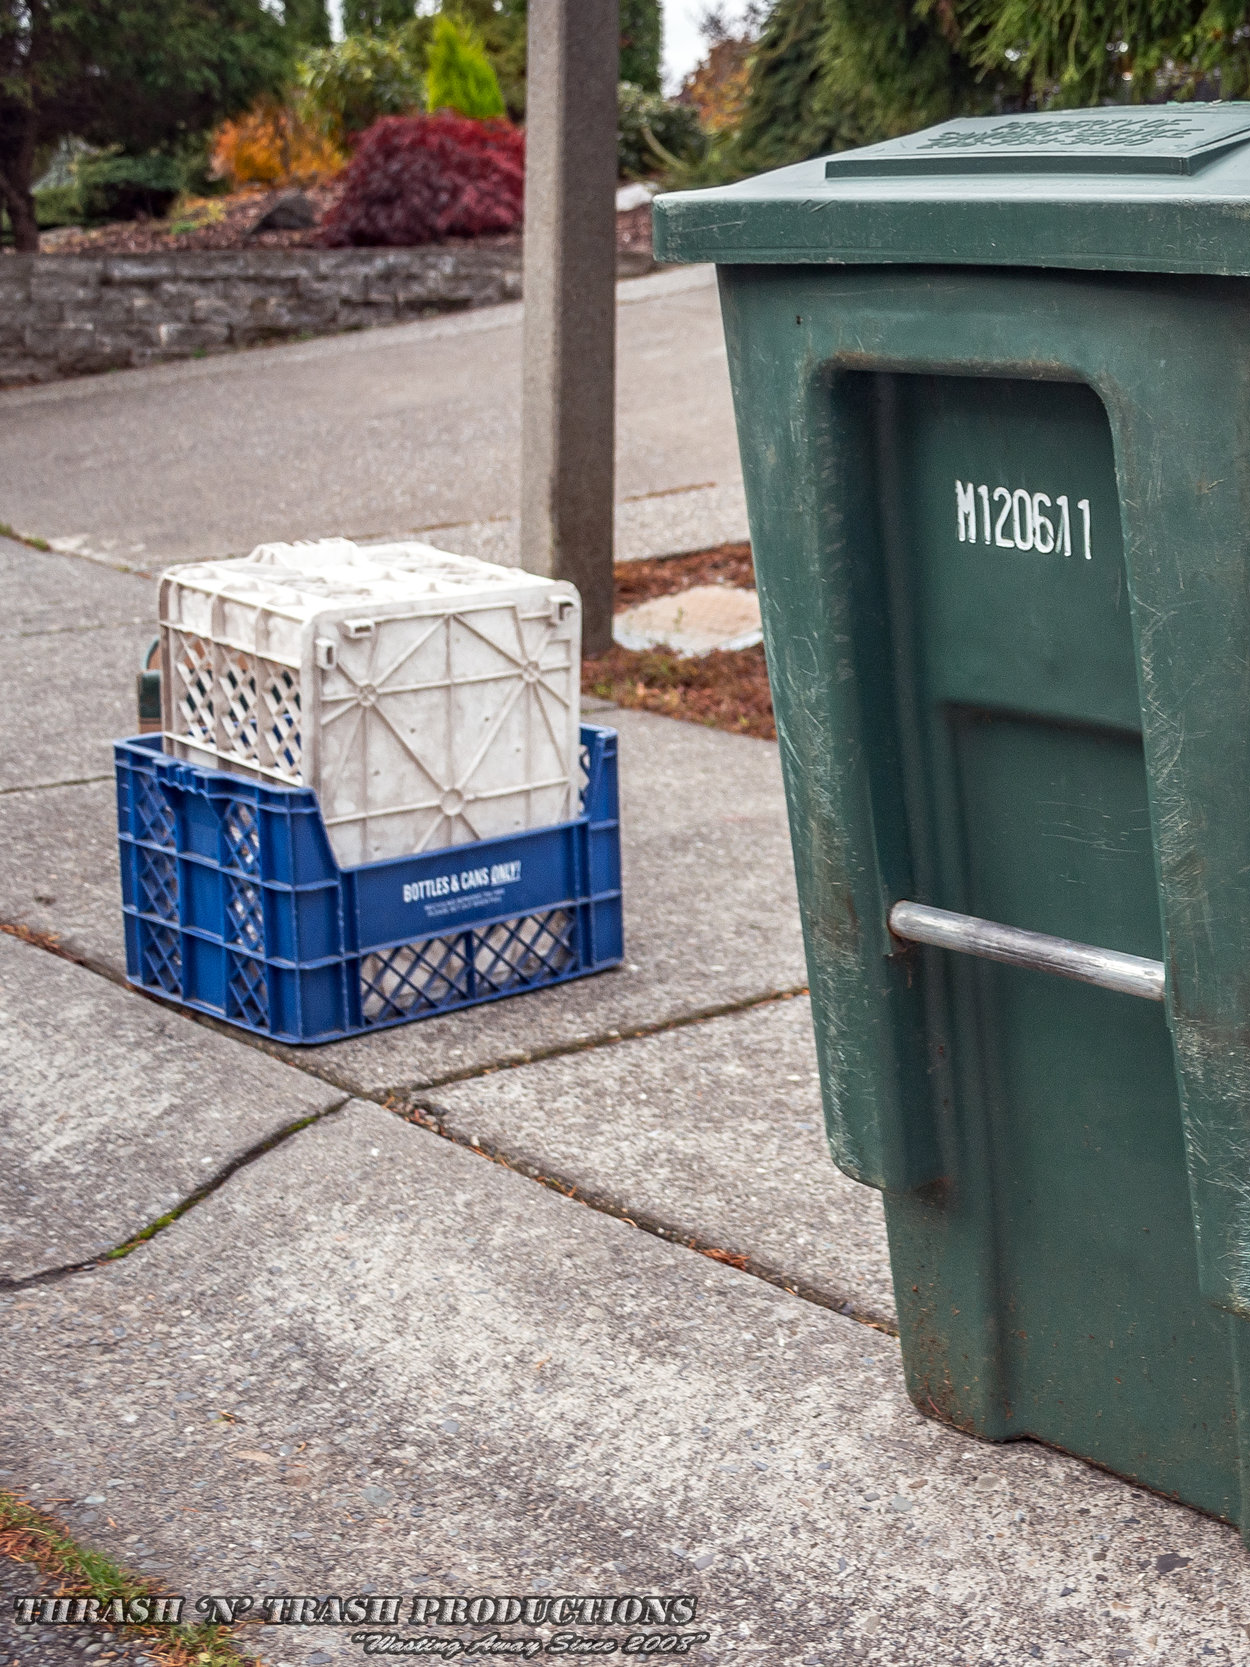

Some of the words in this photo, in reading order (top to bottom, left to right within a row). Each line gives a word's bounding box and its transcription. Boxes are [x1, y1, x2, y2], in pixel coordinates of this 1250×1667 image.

[955, 480, 1092, 560] M120611
[403, 876, 450, 903] BOTTLES
[450, 874, 460, 893] &
[460, 867, 489, 890] CANS
